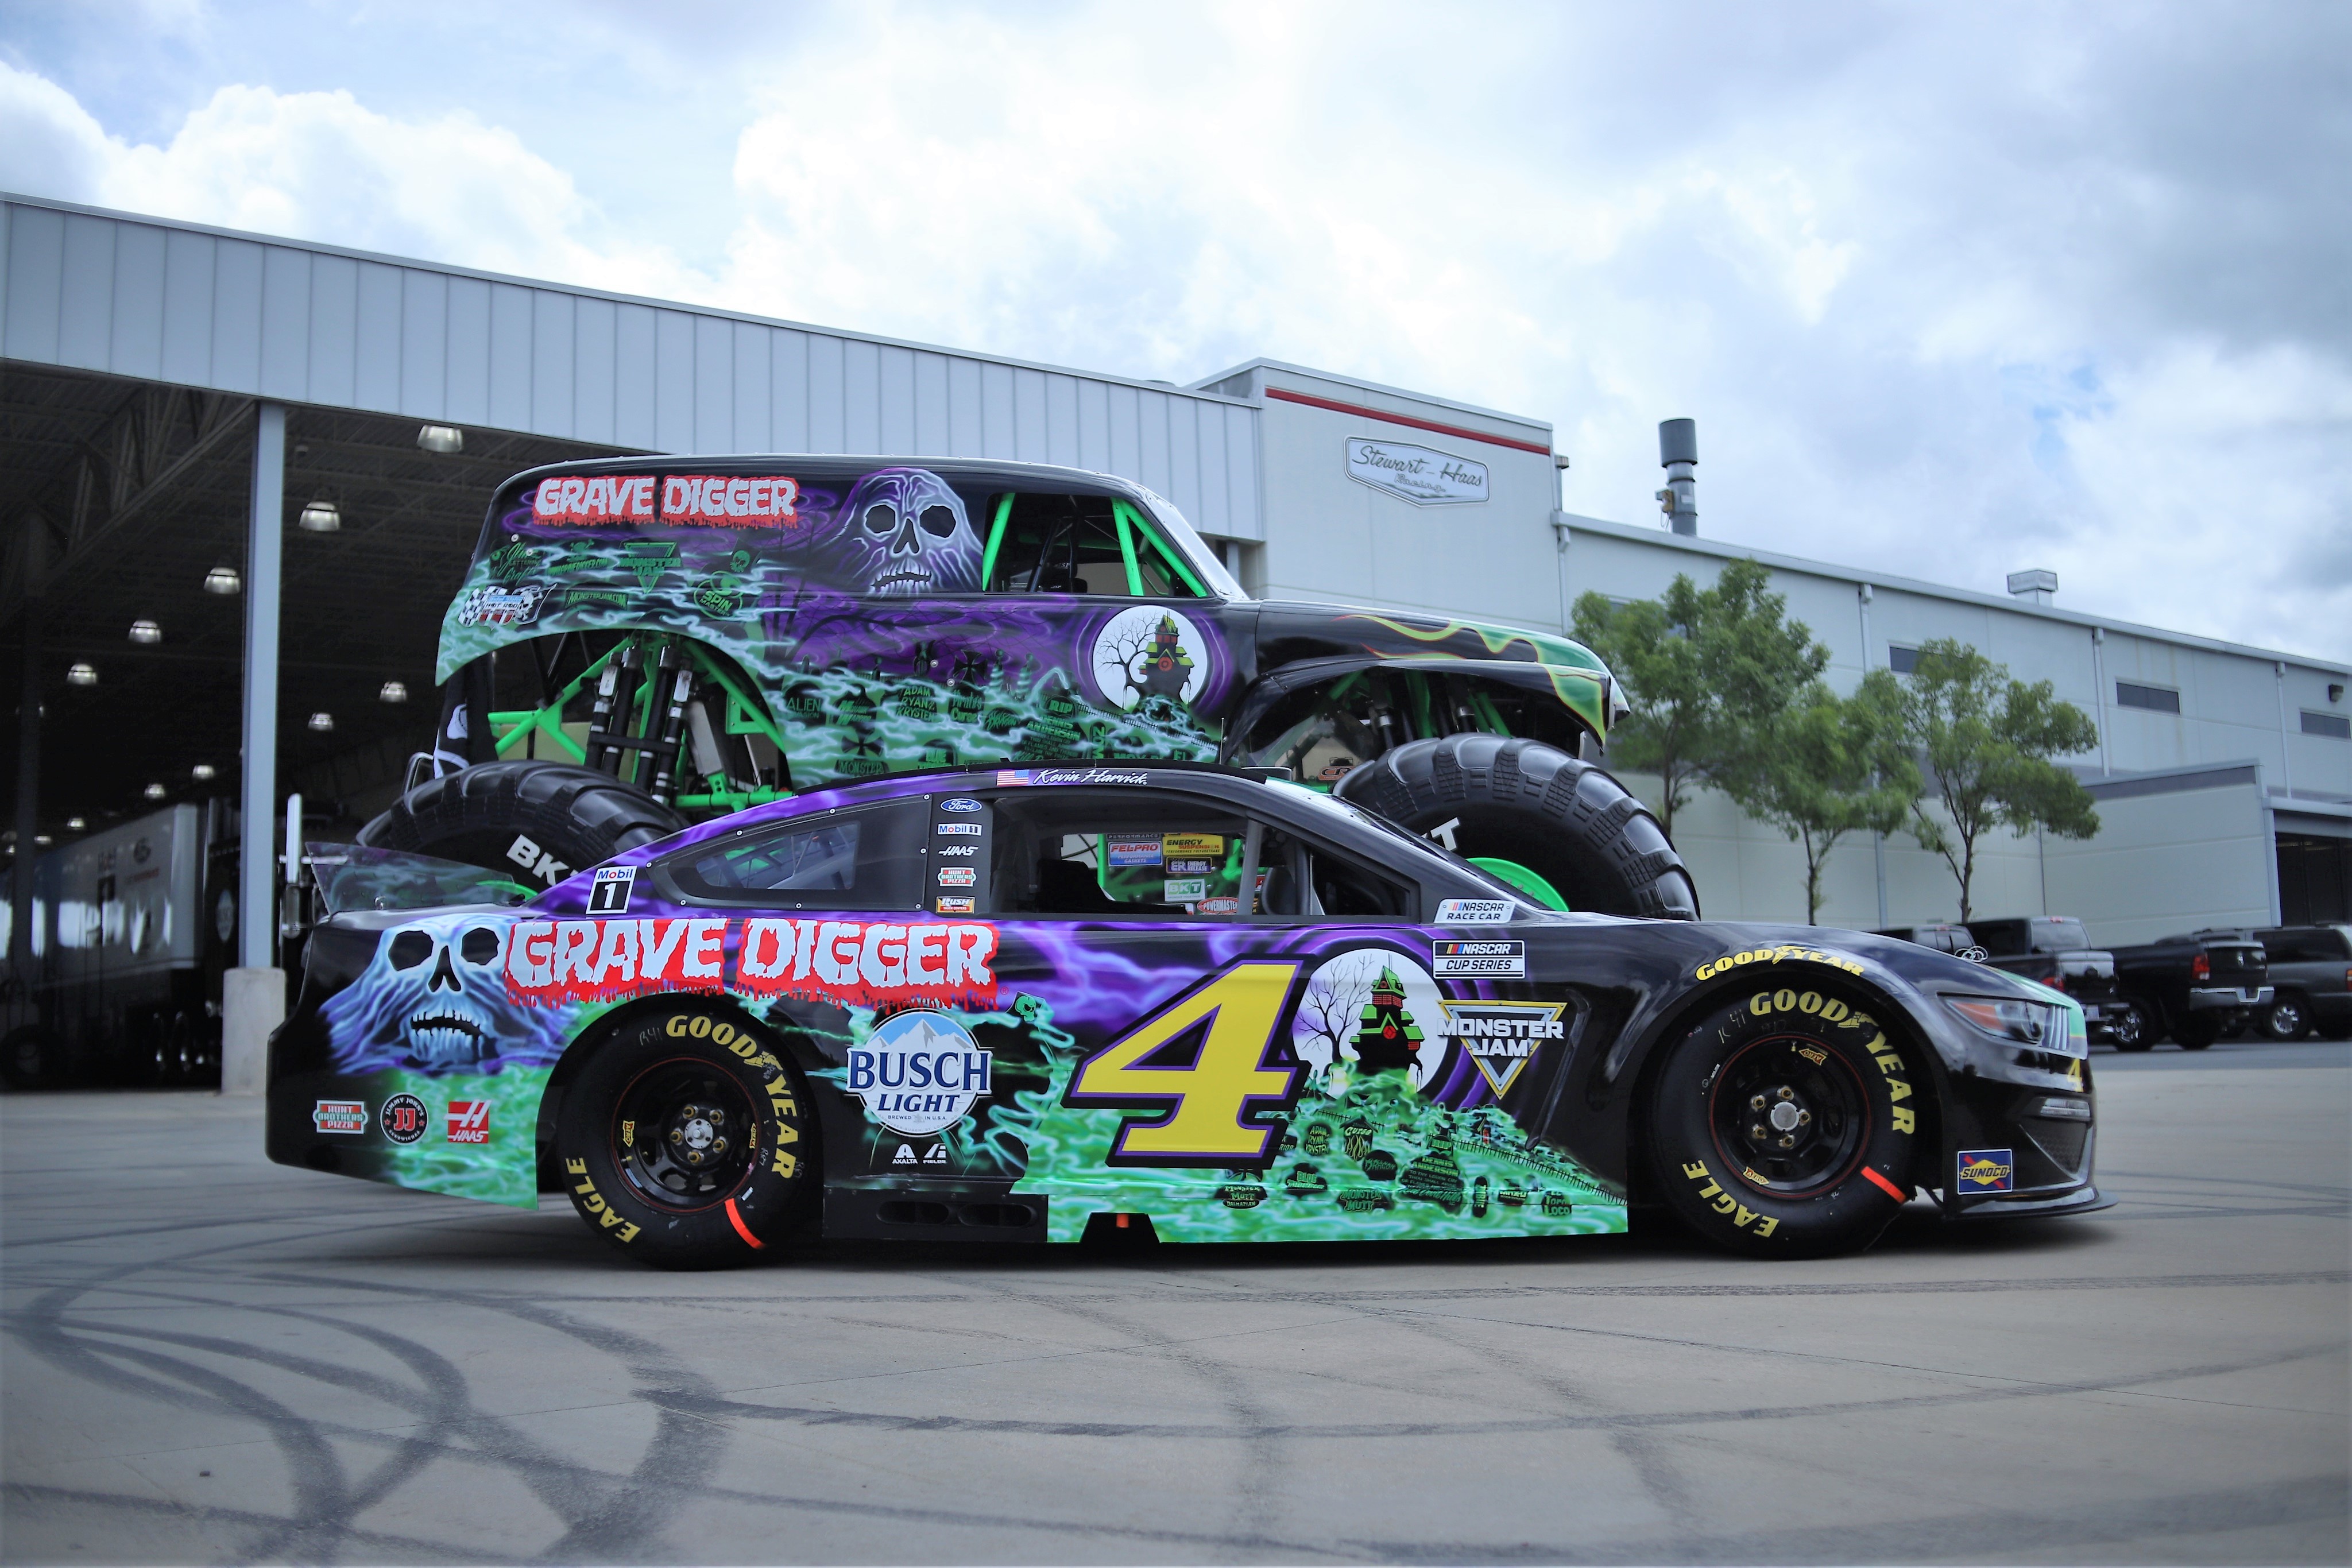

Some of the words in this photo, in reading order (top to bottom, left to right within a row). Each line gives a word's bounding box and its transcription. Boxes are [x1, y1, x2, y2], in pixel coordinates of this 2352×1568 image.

[1352, 445, 1430, 475] Stewart
[1440, 462, 1482, 487] Haas
[1394, 473, 1446, 493] Racing
[535, 477, 656, 517] GRAVE
[663, 477, 796, 517] DIGGER
[620, 557, 682, 567] MONSTER
[633, 567, 664, 576] JAM
[567, 592, 626, 607] MONSTERJAM.COM
[704, 591, 733, 612] SPIN
[903, 686, 931, 696] ADAM
[787, 698, 821, 713] ALIEN
[901, 696, 928, 708] RYAN
[1049, 700, 1073, 713] RIP
[896, 706, 936, 722] KRYSTEN
[839, 760, 884, 775] MONSTER
[1033, 769, 1081, 785] Kevin
[1080, 769, 1148, 785] Harvick
[948, 800, 974, 811] Ford
[938, 846, 979, 856] HAAS
[1111, 843, 1159, 853] FEL-PRO
[506, 834, 579, 887] BK
[1171, 861, 1187, 872] ER
[597, 868, 634, 880] Mobil
[1168, 882, 1202, 895] BKT
[603, 883, 618, 909] 1
[942, 897, 971, 907] RUSH
[1463, 903, 1504, 912] NASCAR
[506, 919, 726, 989] GRAVE
[743, 918, 993, 989] DIGGER
[1462, 944, 1511, 954] NASCAR
[1446, 960, 1469, 970] CUP
[1471, 960, 1512, 970] SERIES
[1696, 945, 1864, 981] GOODYEAR
[1437, 1018, 1565, 1039] MONSTER
[1472, 1038, 1529, 1057] JAM
[1073, 961, 1302, 1155] 4
[1749, 989, 1916, 1135] GOODYEAR
[849, 1050, 989, 1091] BUSCH
[666, 1015, 799, 1179] GOODYEAR
[877, 1093, 960, 1113] LIGHT
[327, 1105, 353, 1114] HUNT
[385, 1097, 404, 1116] JIMMY
[405, 1097, 424, 1117] JOHN'S
[318, 1113, 363, 1122] BROTHERS
[393, 1108, 416, 1132] JJ
[327, 1120, 354, 1129] PIZZA
[448, 1129, 489, 1142] HAAS
[1307, 1135, 1324, 1144] RYAN
[1305, 1143, 1330, 1155] KRYSTEN
[1364, 1158, 1395, 1171] DRAGON
[1422, 1156, 1454, 1168] DENNIS
[1412, 1161, 1459, 1178] ANDERSON
[1962, 1167, 2008, 1178] SUNOCO
[1297, 1171, 1317, 1183] BLUE
[1231, 1192, 1255, 1201] MUTT
[1341, 1188, 1382, 1199] MONSTER
[1682, 1159, 1780, 1238] EAGLE
[566, 1157, 641, 1244] EAGLE
[1347, 1199, 1372, 1210] MUTT
